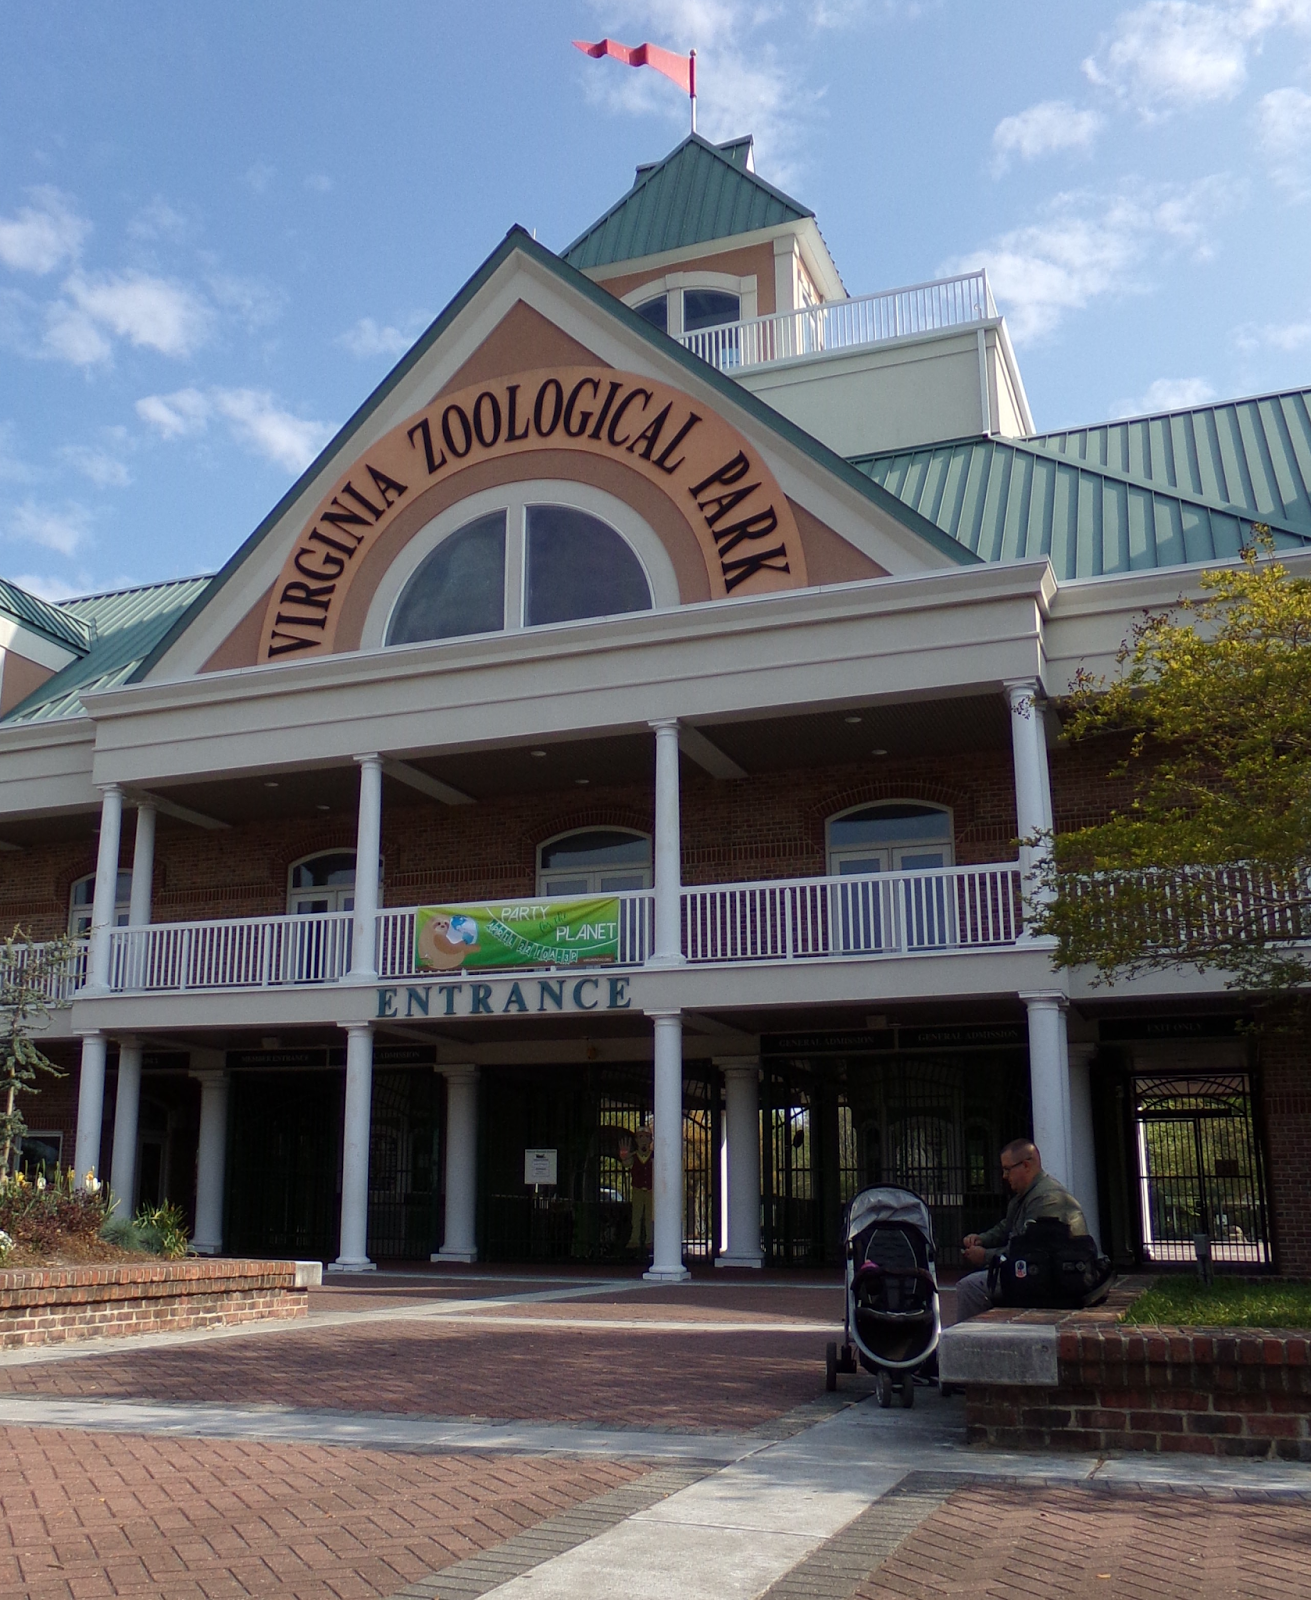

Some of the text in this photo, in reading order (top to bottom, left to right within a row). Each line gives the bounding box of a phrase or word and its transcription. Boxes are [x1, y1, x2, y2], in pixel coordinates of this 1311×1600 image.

[267, 376, 791, 659] VIRGINIA ZOOLOGICAL PARK
[501, 905, 550, 922] PARTY
[486, 922, 514, 947] APRIL
[518, 942, 532, 955] 22
[556, 922, 617, 942] PLANET
[376, 976, 632, 1018] ENTRANCE
[918, 1030, 1018, 1041] GENERAL ADMISSION
[1147, 1022, 1203, 1032] EXIT ONLY
[779, 1036, 874, 1047] GENERAL ADMISSION
[380, 1051, 420, 1059] ADMISSION
